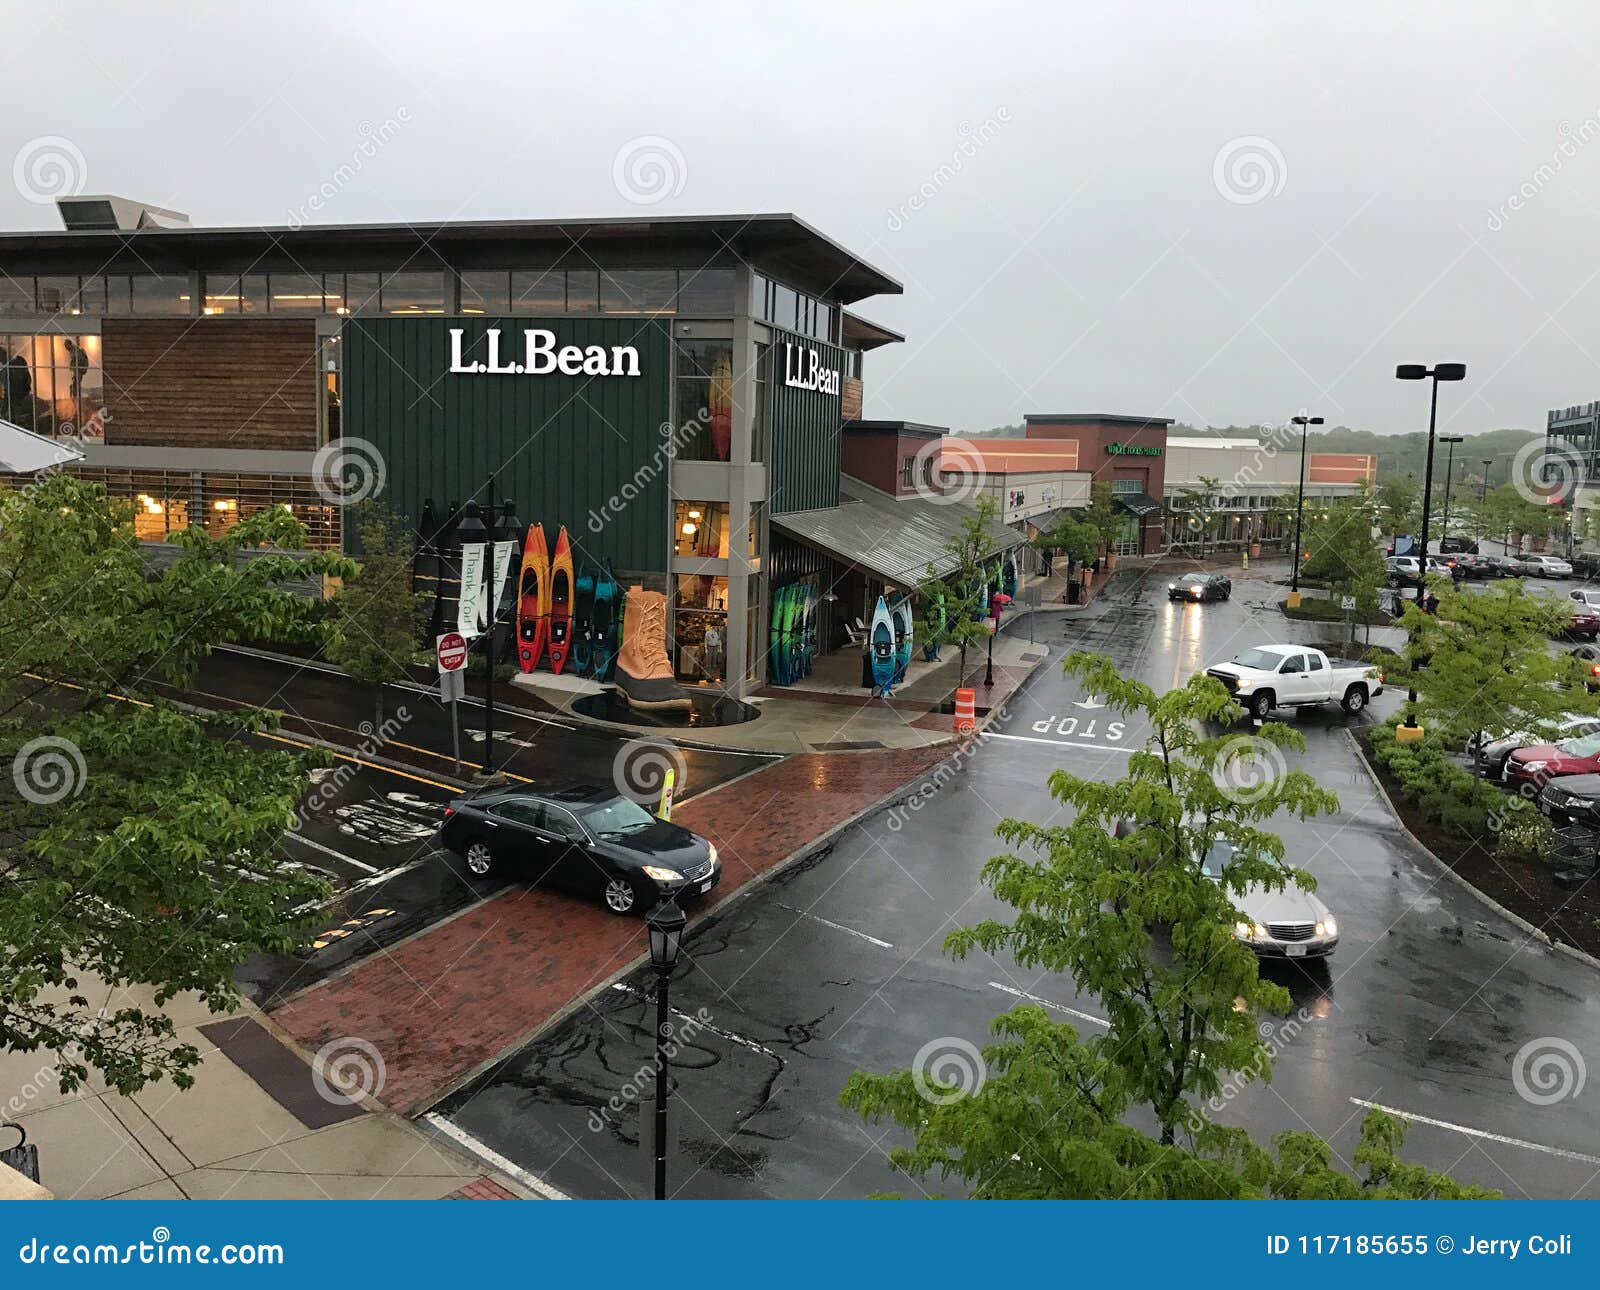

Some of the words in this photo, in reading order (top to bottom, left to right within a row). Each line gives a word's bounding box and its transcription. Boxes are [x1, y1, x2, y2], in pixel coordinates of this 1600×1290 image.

[449, 328, 641, 376] L.L.Bean
[785, 342, 840, 396] L.L.Bean
[464, 548, 480, 592] Thank
[1031, 715, 1126, 740] STOP
